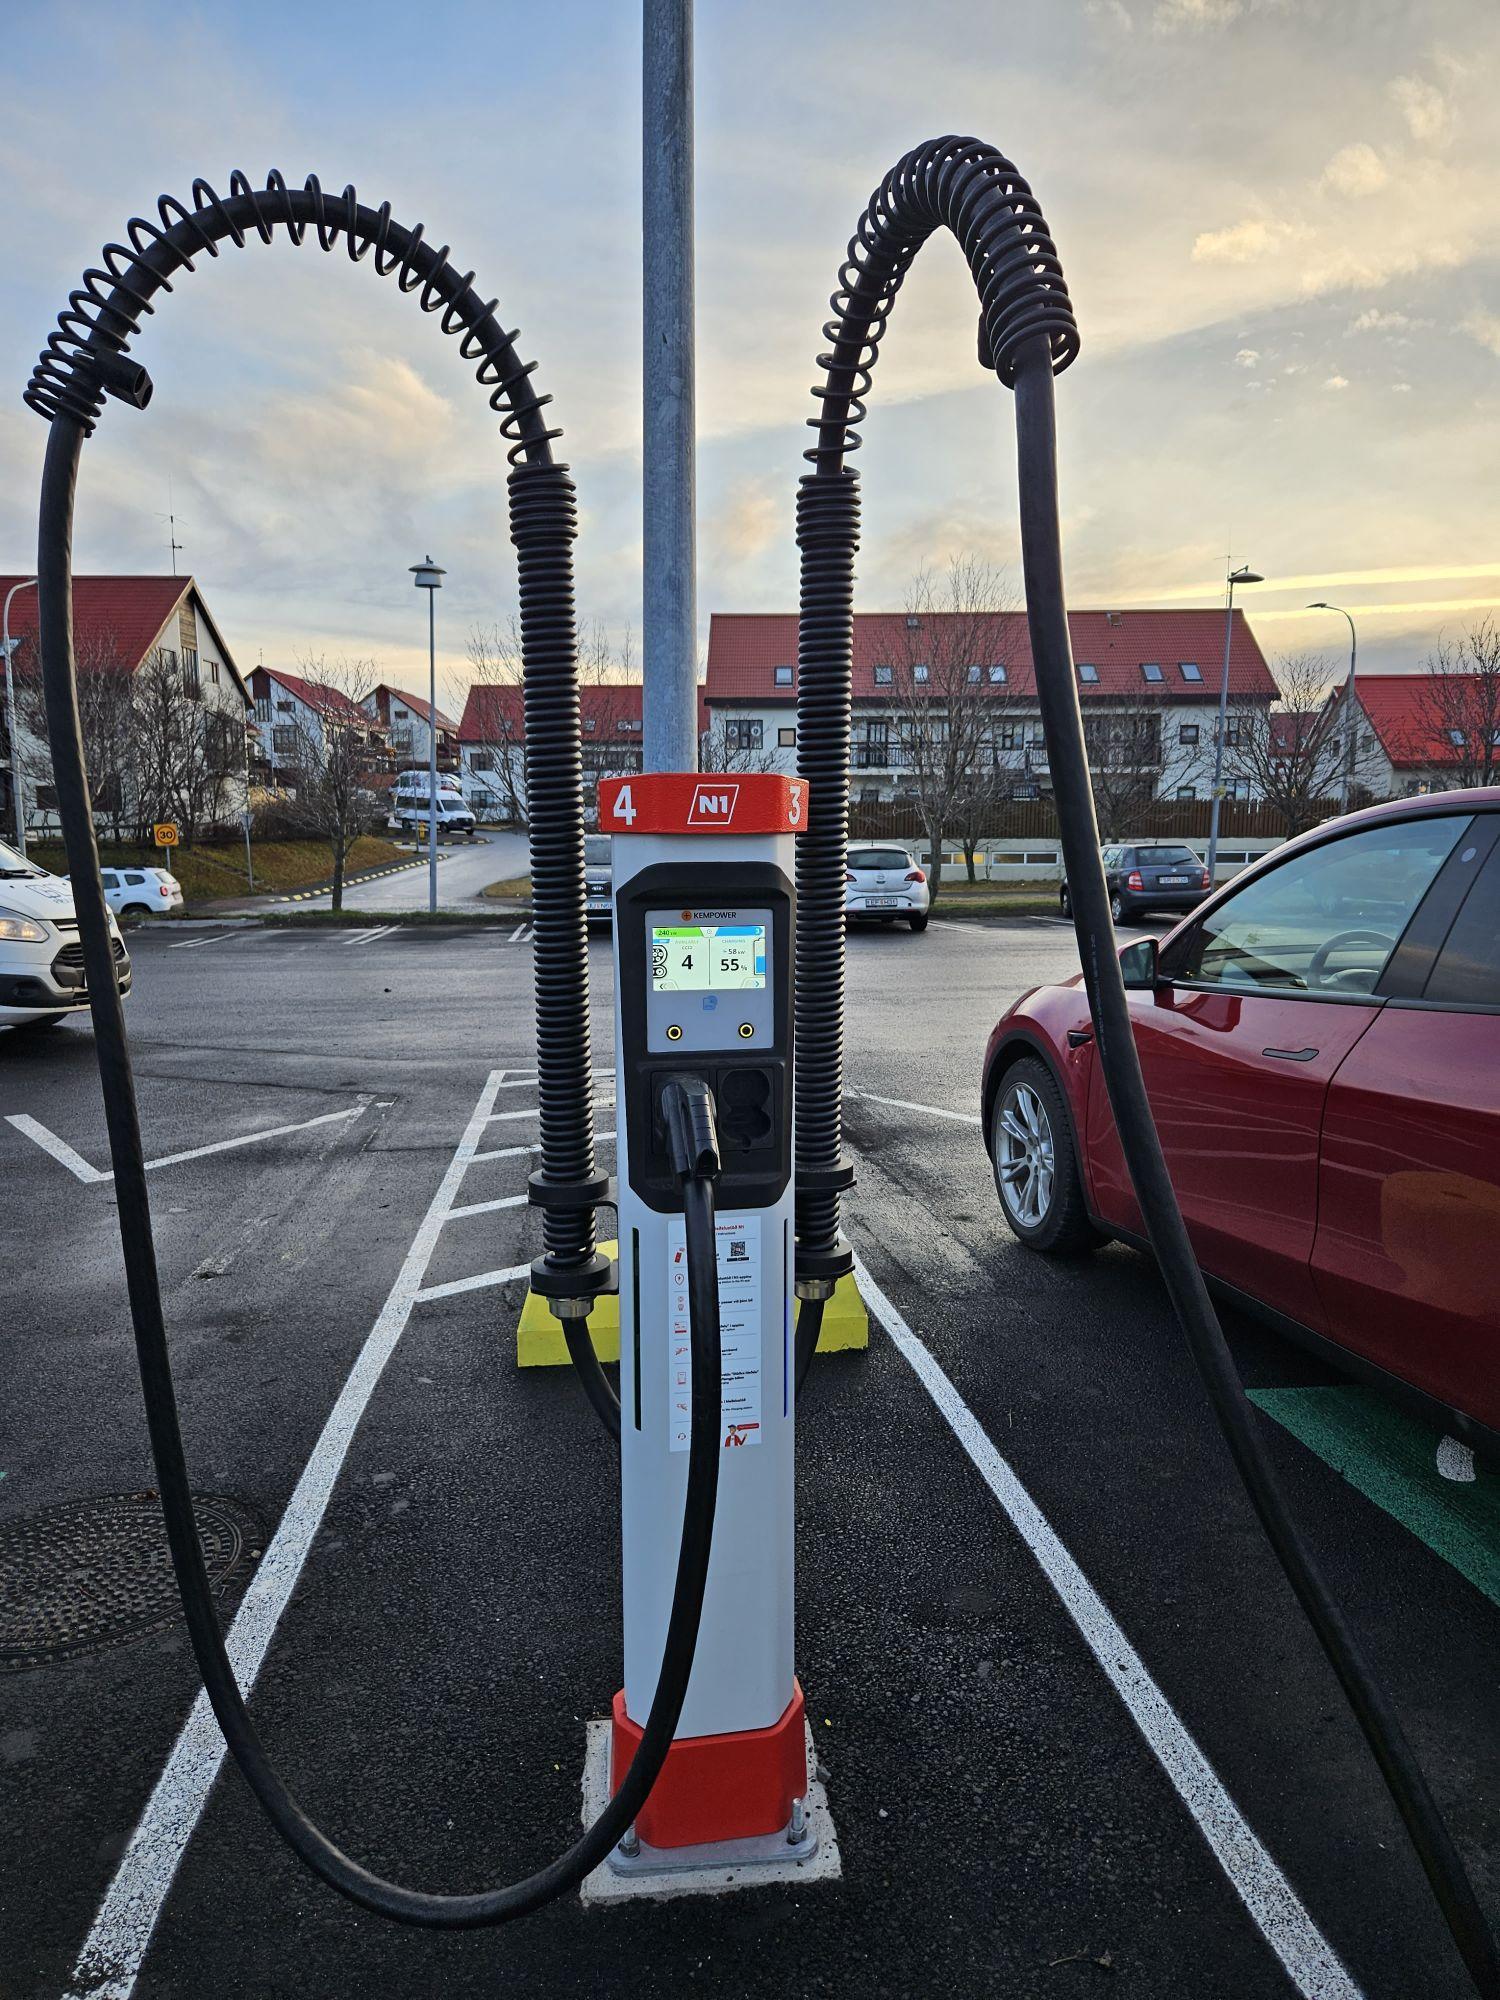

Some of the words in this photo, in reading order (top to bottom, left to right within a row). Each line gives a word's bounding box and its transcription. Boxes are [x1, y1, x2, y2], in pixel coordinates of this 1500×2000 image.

[613, 785, 637, 826] 4
[699, 795, 728, 814] N1
[788, 786, 801, 825] 3
[160, 831, 173, 839] 30
[693, 911, 737, 919] KEMPOWER
[681, 954, 694, 970] 4
[720, 958, 740, 972] 55
